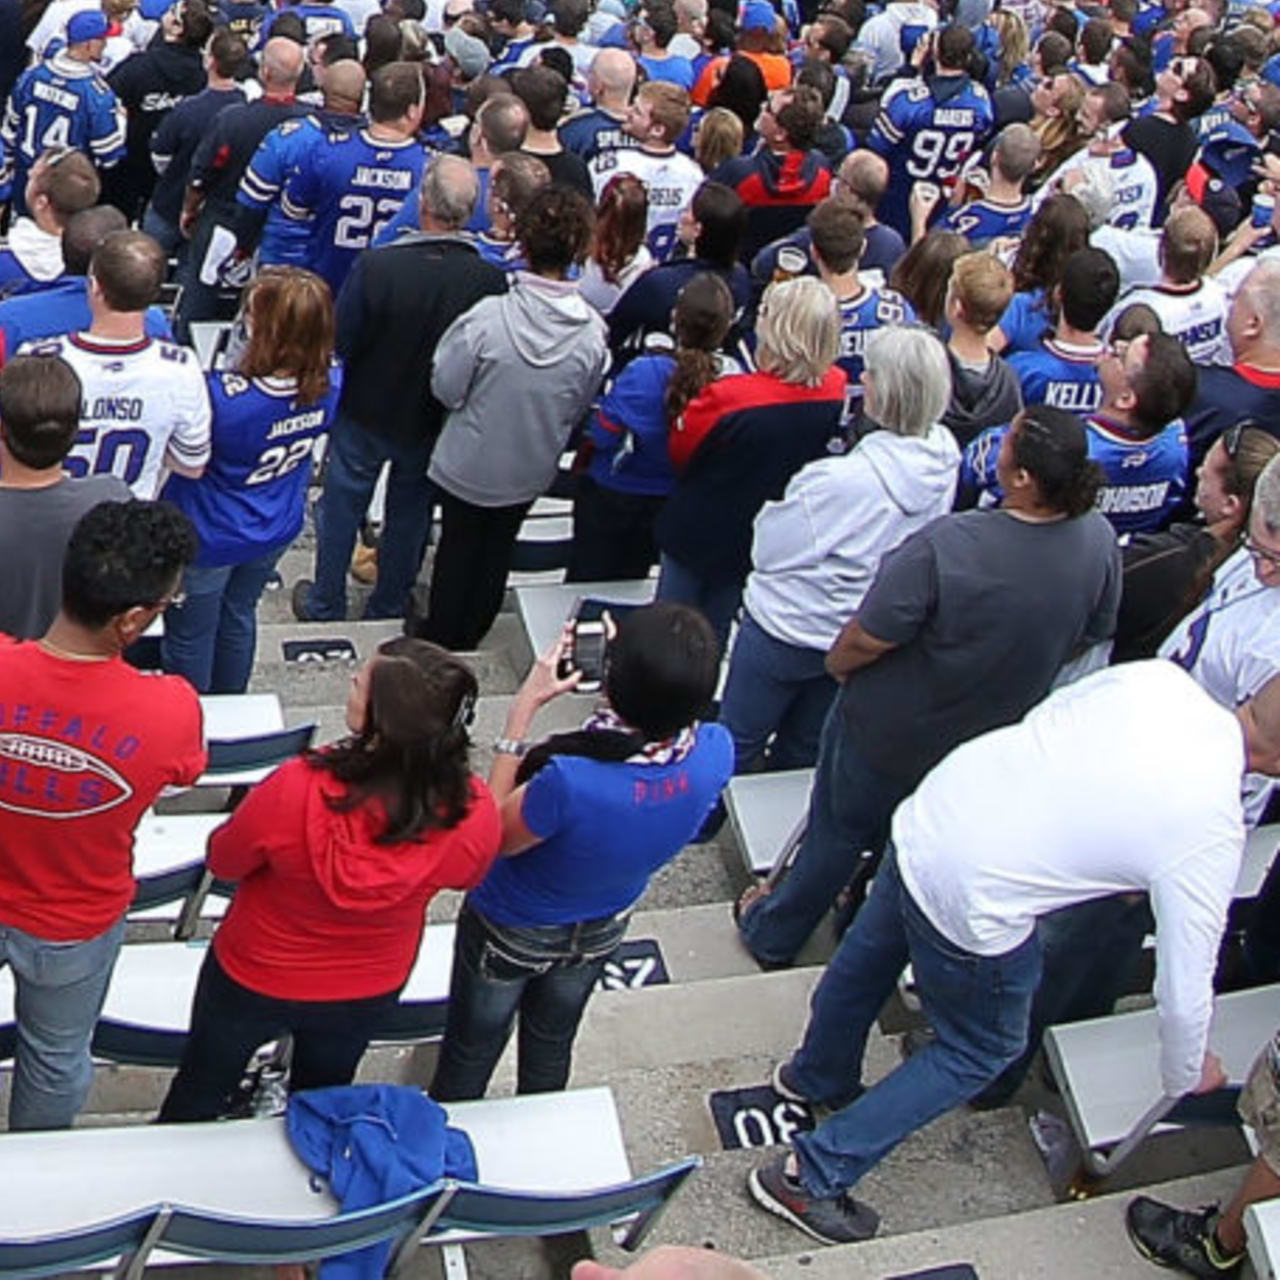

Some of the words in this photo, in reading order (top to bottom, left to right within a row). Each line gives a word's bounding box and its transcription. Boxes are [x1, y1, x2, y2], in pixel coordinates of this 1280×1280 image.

[24, 104, 71, 158] 14
[906, 130, 974, 179] 99
[350, 167, 412, 192] JACKSON
[646, 186, 683, 208] REUS
[82, 397, 144, 422] LONSO
[1044, 382, 1104, 411] KELLY
[266, 409, 325, 441] JACKSON
[244, 439, 316, 486] 22
